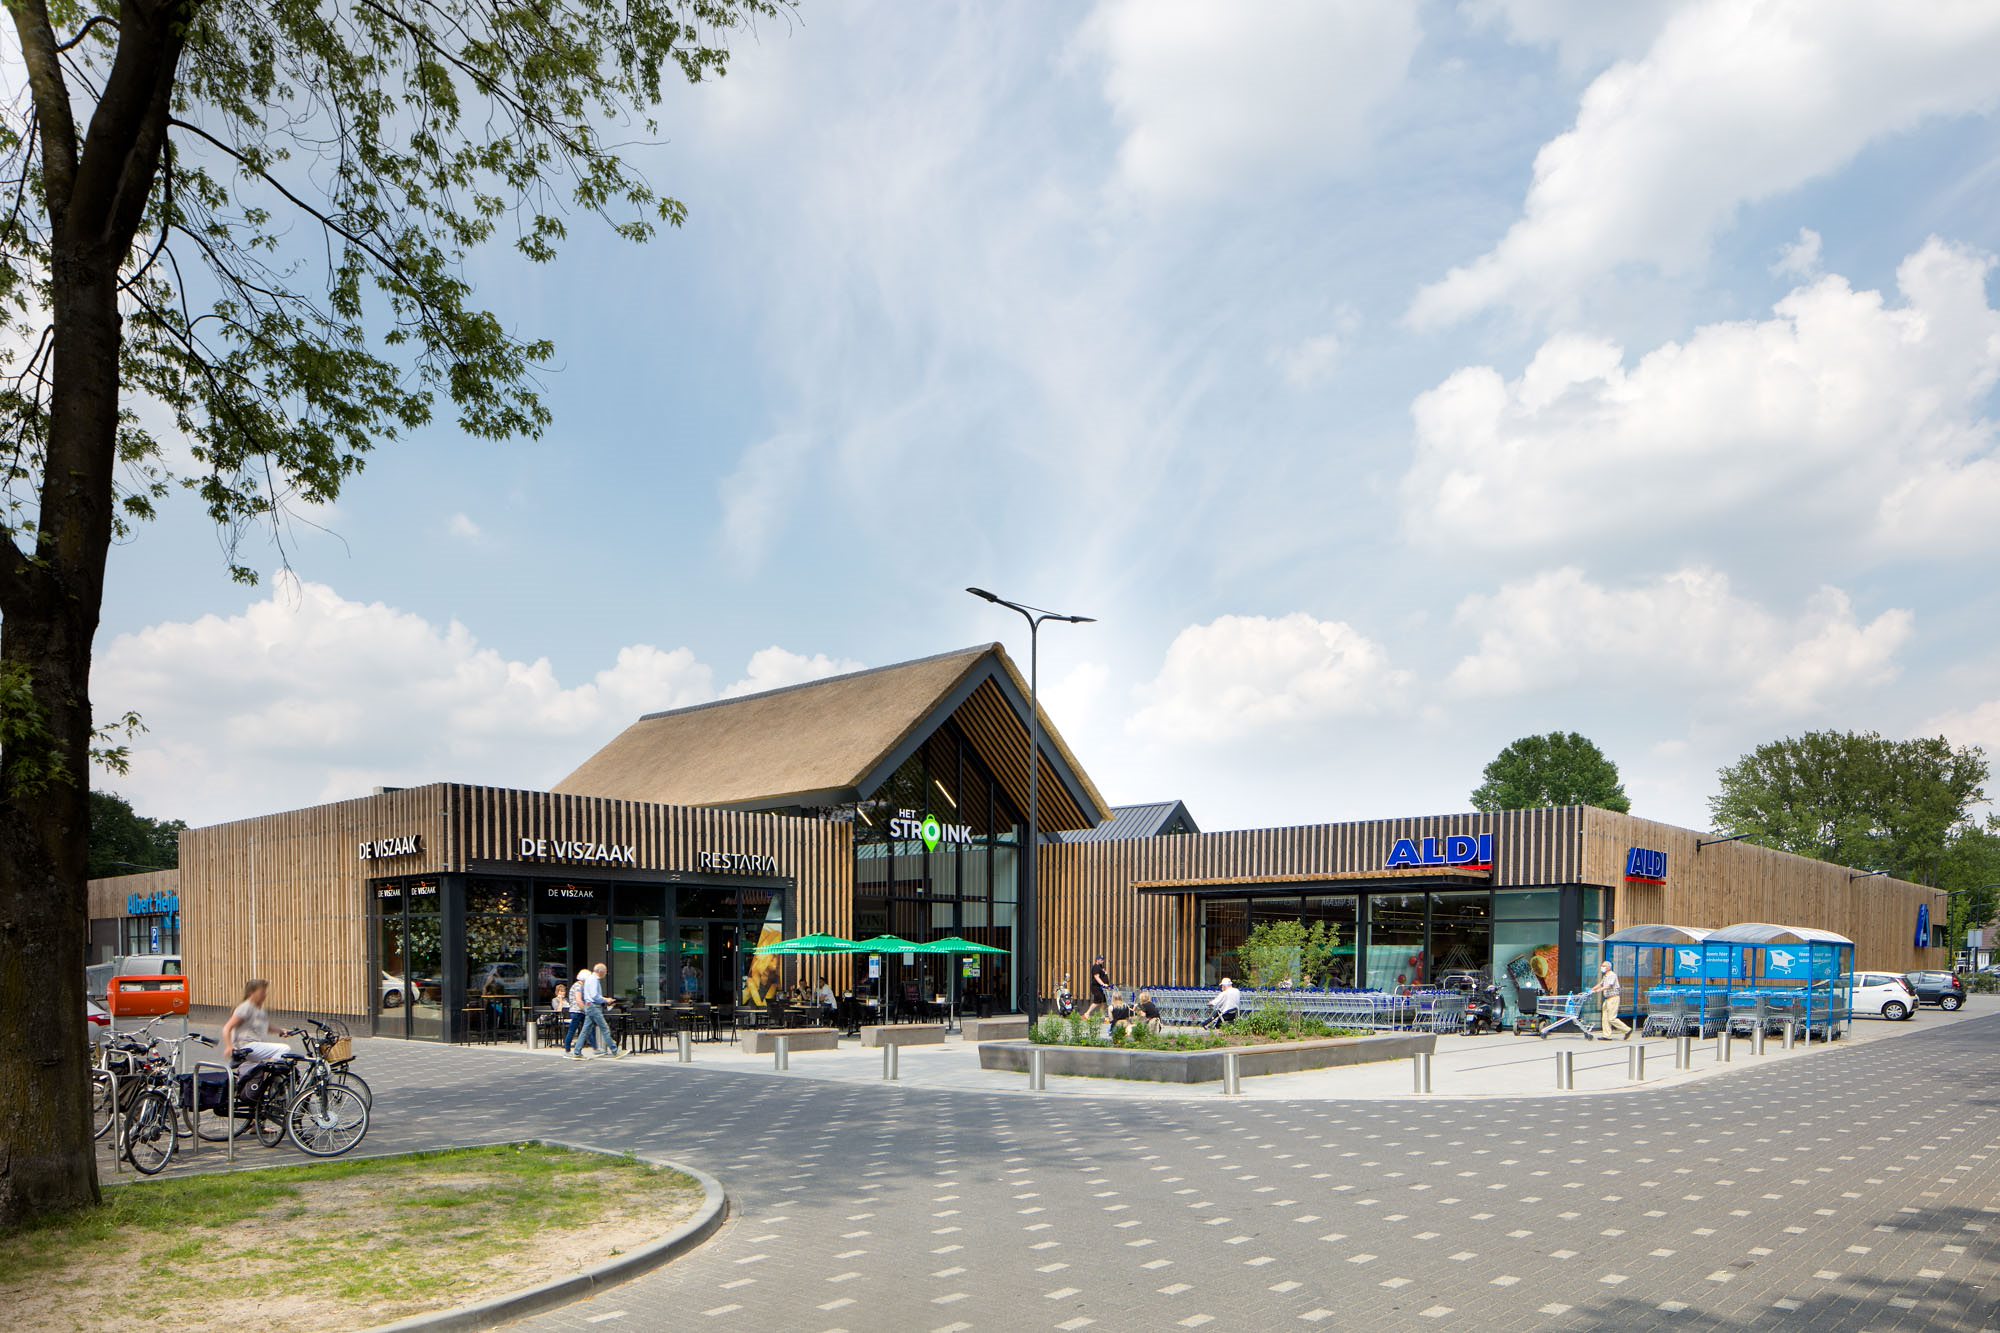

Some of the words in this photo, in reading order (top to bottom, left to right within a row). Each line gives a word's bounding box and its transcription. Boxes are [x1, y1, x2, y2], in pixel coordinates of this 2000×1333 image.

[899, 809, 916, 818] HET
[890, 818, 972, 844] STROINK
[360, 842, 371, 859] DE
[374, 835, 416, 858] VISZAAK
[521, 838, 547, 857] DE
[554, 841, 635, 863] VISZAAK
[1385, 833, 1492, 866] ALDI
[701, 851, 777, 871] RESTARIA
[1629, 847, 1667, 879] ALDI
[378, 890, 383, 898] DE
[384, 889, 401, 897] VISZAAK
[411, 888, 417, 896] DE
[418, 886, 436, 895] VISZAAK
[548, 889, 558, 897] DE
[561, 889, 594, 898] VISZAAK
[128, 892, 153, 915] Albert
[155, 890, 179, 917] Heijn
